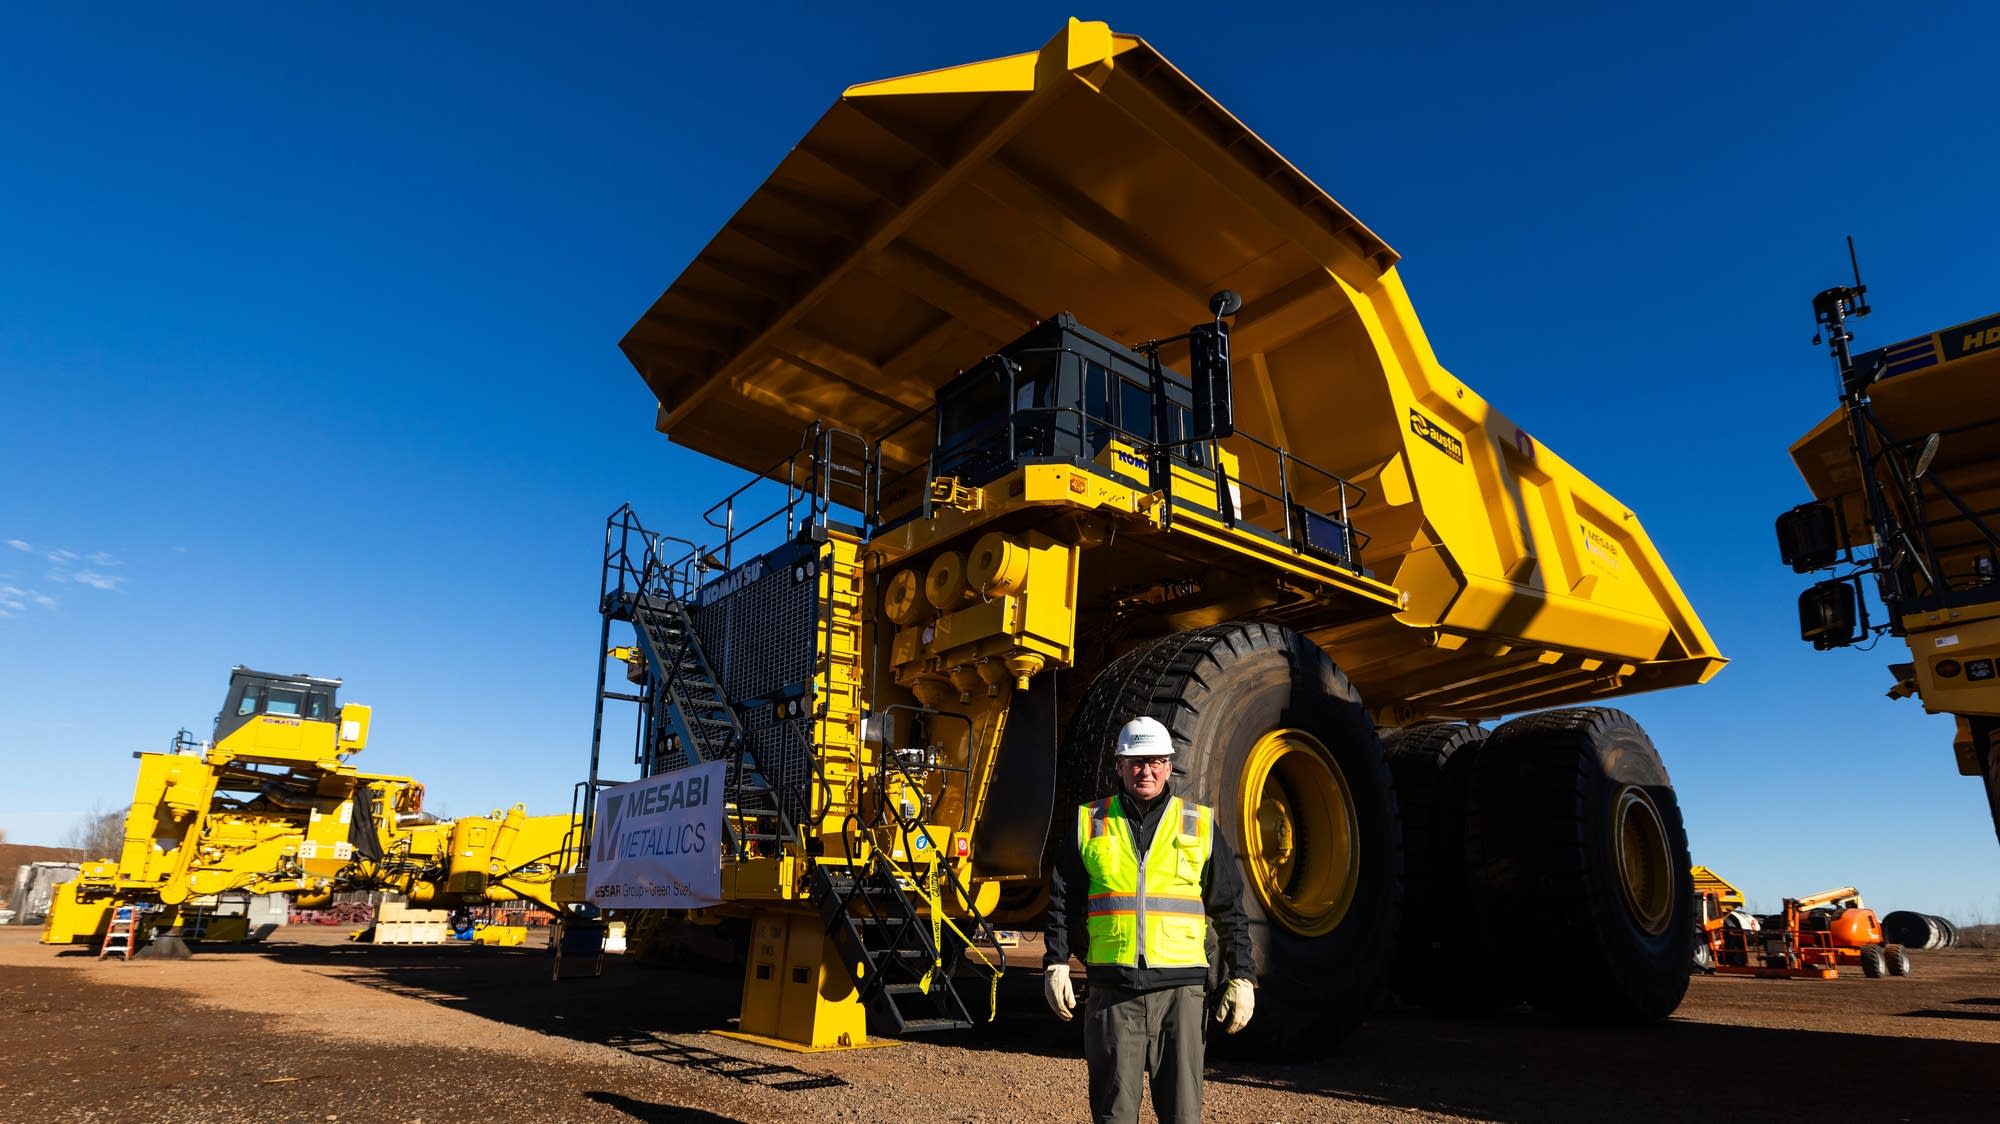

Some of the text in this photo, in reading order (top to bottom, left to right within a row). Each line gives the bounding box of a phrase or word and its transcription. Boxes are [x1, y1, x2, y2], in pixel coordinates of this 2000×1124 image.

[1430, 428, 1461, 456] austin
[702, 560, 761, 607] KOMATSU
[263, 718, 300, 726] KOMATSU
[626, 774, 710, 818] MESABI
[618, 822, 706, 859] METALLICS
[623, 883, 644, 901] Group
[648, 881, 671, 897] Green
[931, 871, 940, 898] CAUTION
